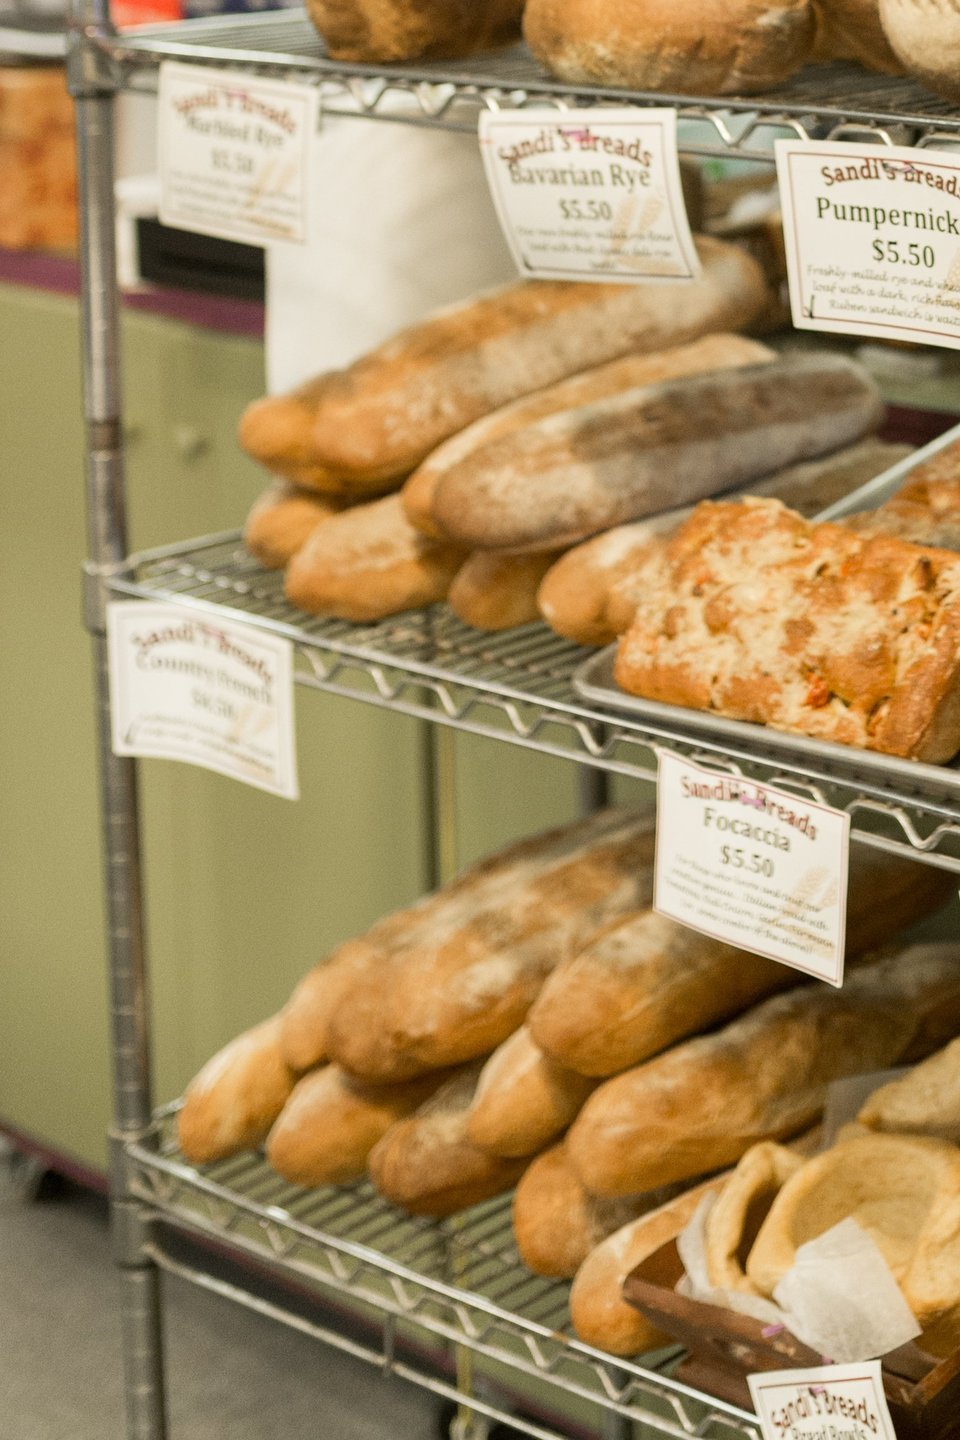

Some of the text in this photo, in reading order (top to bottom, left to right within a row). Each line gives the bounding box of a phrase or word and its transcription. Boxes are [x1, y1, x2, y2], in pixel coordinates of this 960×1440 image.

[509, 163, 651, 193] Bavarian Rye
[821, 158, 896, 187] Sandi's
[559, 199, 613, 221] $5.50
[872, 239, 935, 269] $5.50
[703, 806, 791, 853] Focaccia
[720, 844, 775, 879] $5.50
